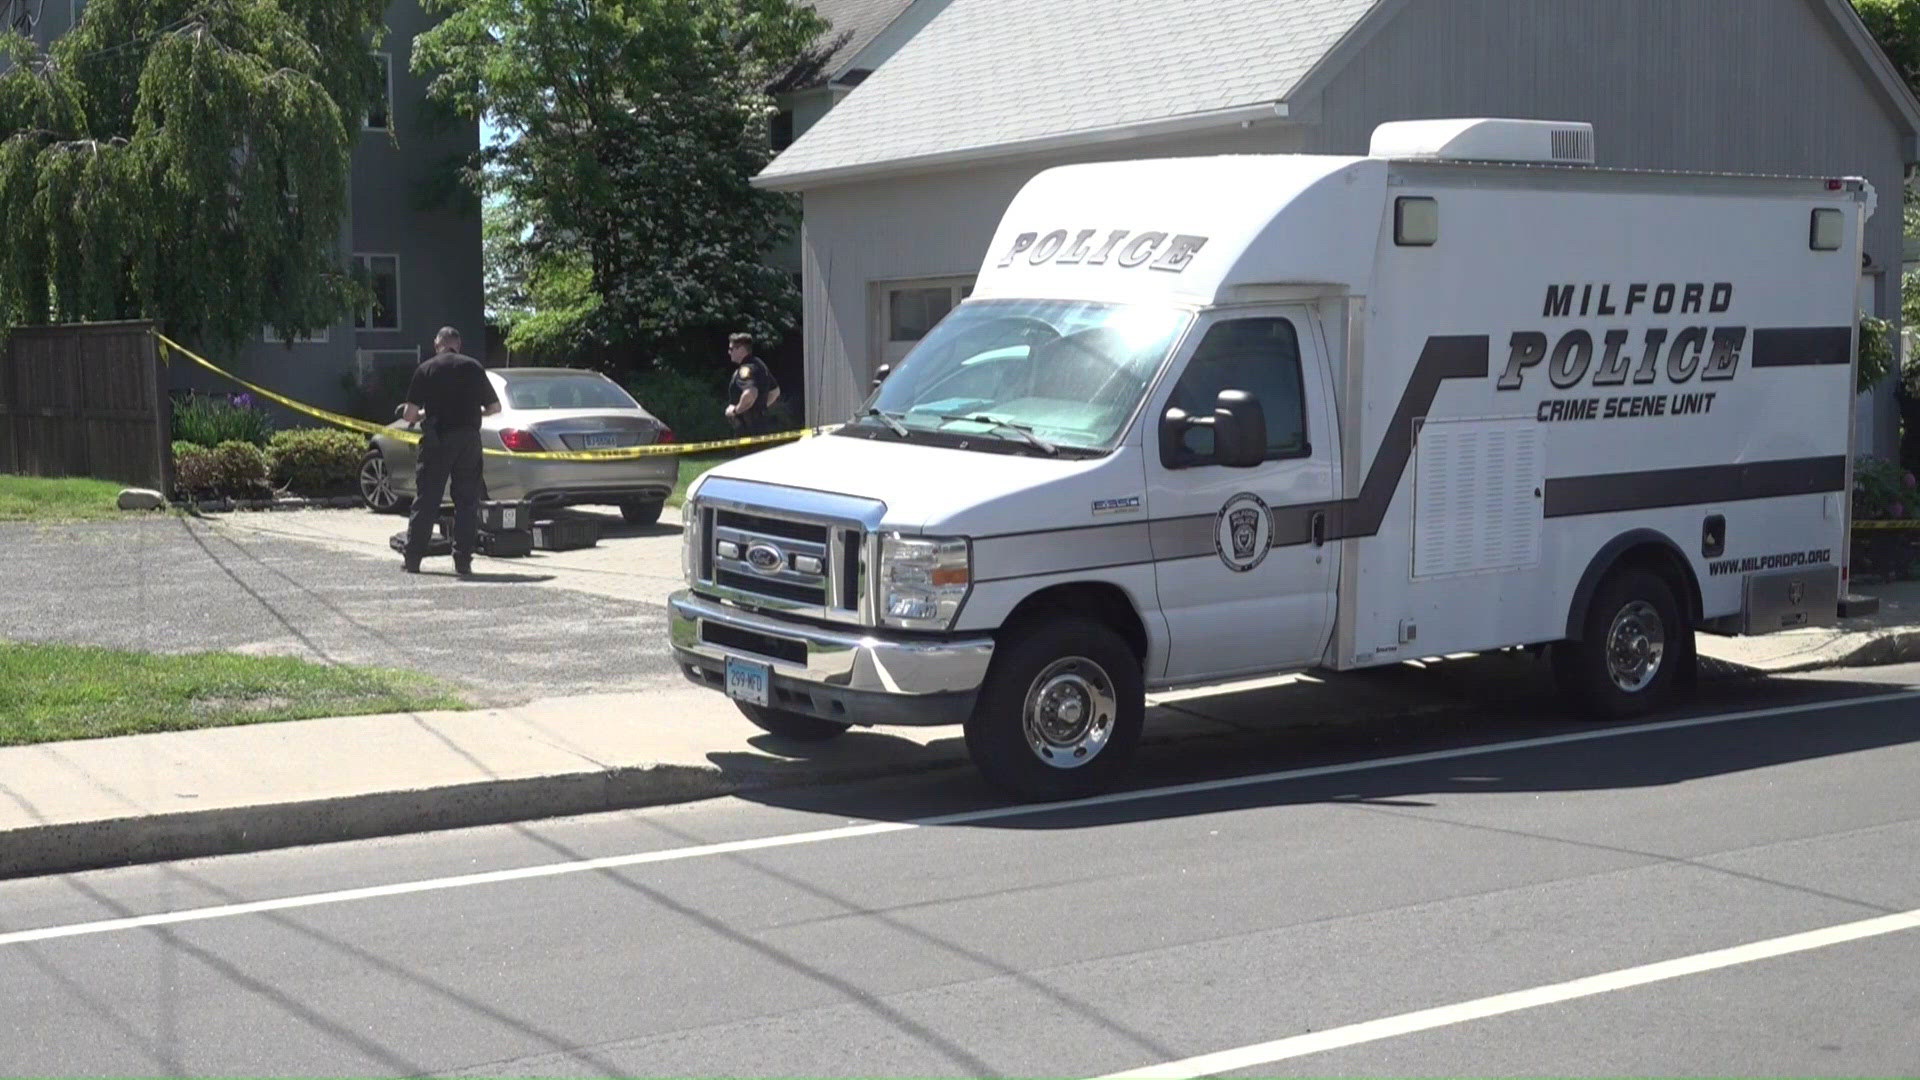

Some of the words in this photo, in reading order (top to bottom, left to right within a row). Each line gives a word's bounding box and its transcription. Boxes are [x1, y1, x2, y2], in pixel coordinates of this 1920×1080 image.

[998, 229, 1209, 273] POLICE
[1543, 282, 1733, 317] MILFORD
[1497, 326, 1747, 391] POLICE
[1537, 399, 1600, 422] CRIME
[1603, 395, 1667, 418] SCENE
[1671, 392, 1716, 415] UNIT
